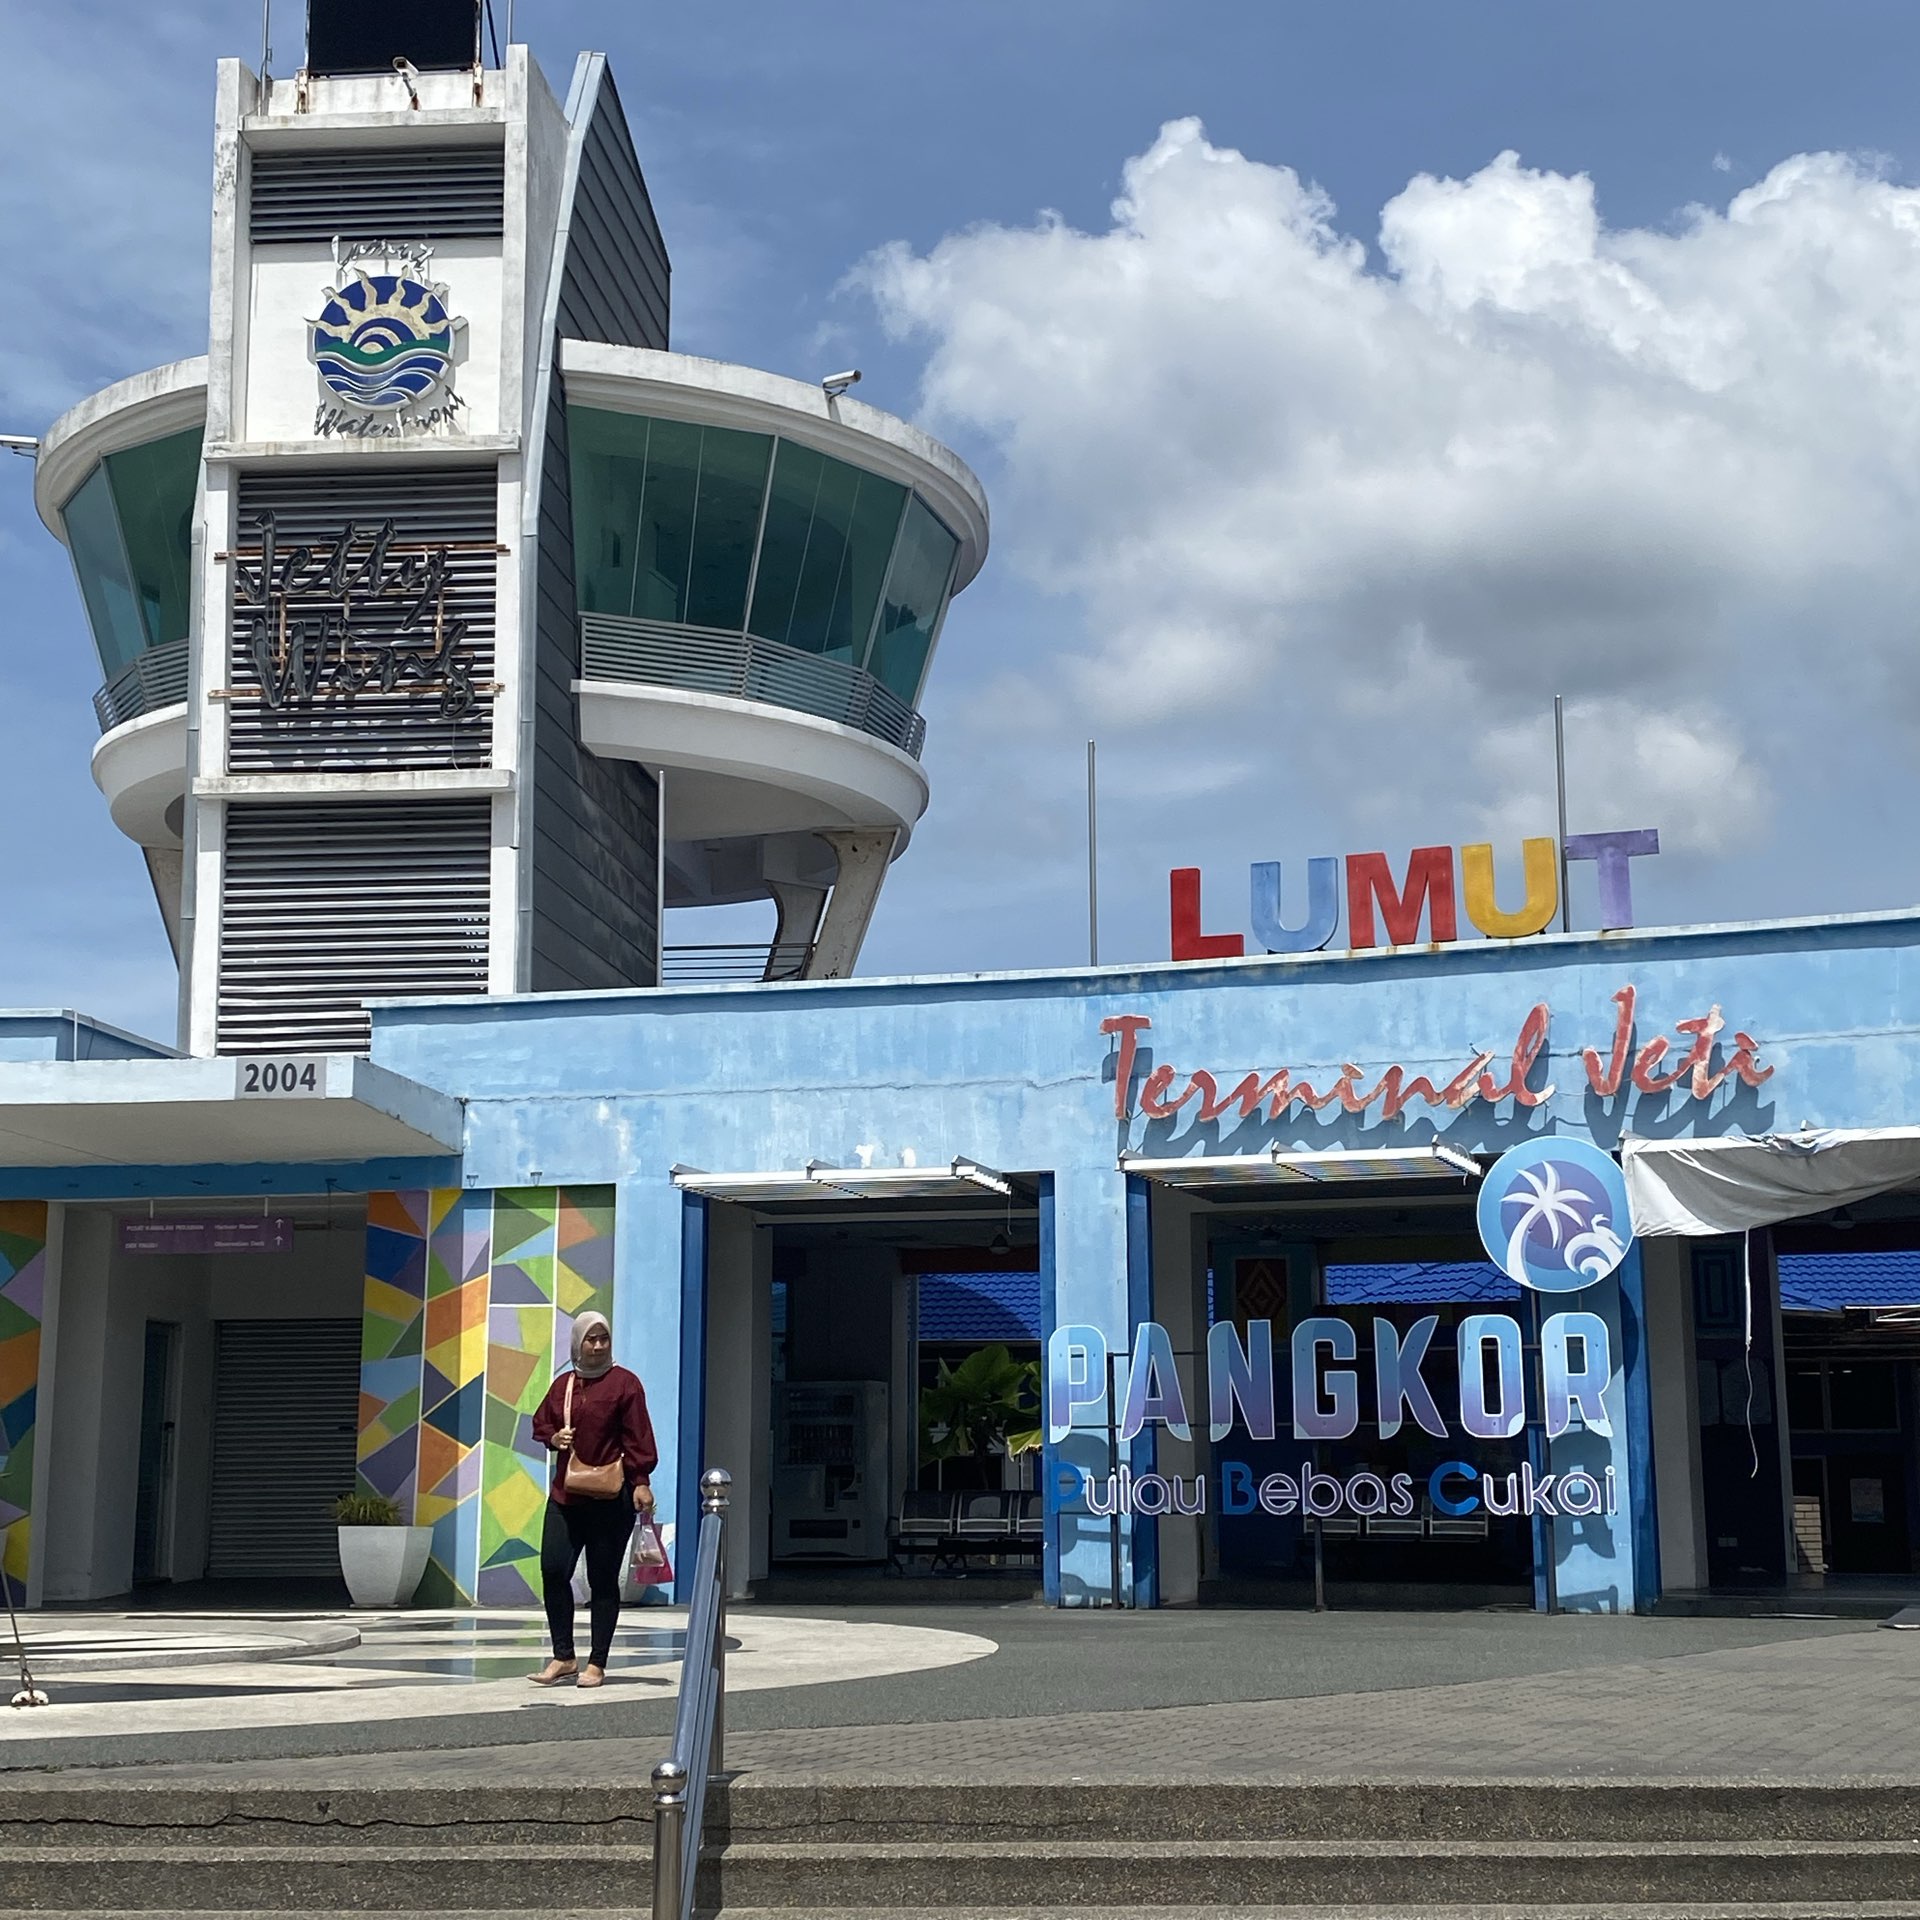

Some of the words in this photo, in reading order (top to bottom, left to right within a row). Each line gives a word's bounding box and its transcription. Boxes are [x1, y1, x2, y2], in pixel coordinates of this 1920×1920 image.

[331, 234, 435, 272] Lumut
[236, 510, 452, 630] Jetty
[1170, 829, 1660, 961] LUMUT
[244, 1063, 317, 1092] 2004
[1100, 1003, 1555, 1122] Terminal
[1582, 984, 1775, 1099] Jeti
[1048, 1312, 1614, 1444] PANGKOR
[1051, 1461, 1206, 1516] Pulau
[1222, 1461, 1413, 1516] Bebas
[1429, 1461, 1617, 1517] Cukai
